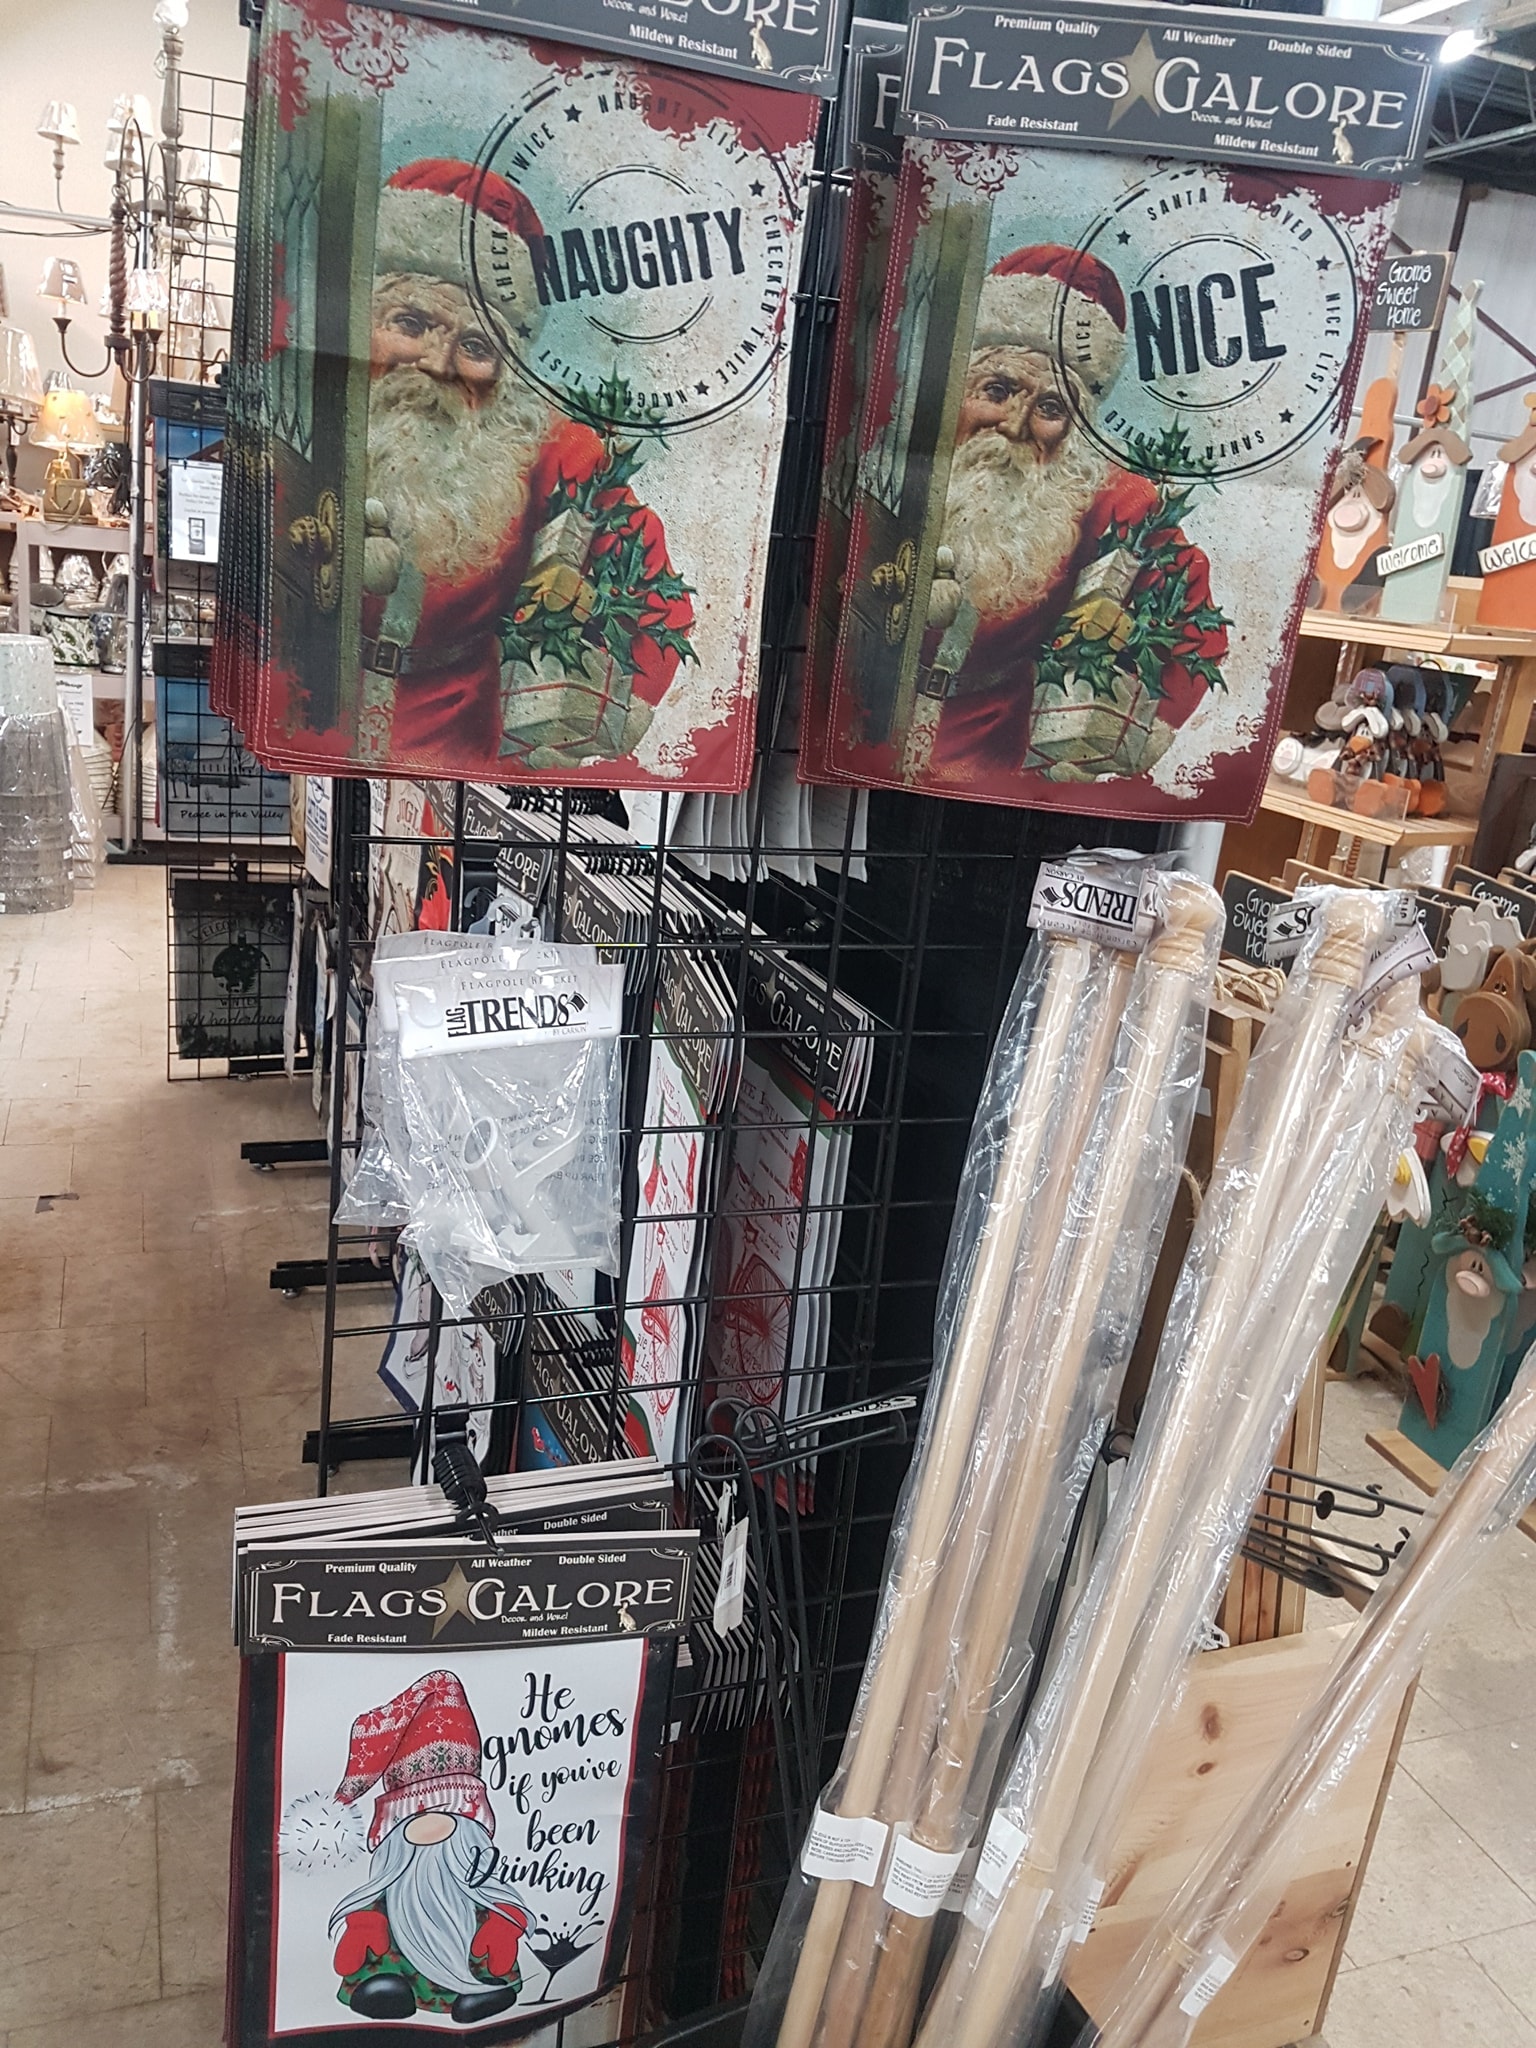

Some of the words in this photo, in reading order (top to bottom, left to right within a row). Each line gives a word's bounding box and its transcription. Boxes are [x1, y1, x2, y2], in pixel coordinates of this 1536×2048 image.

[629, 24, 674, 45] Mildew
[678, 35, 738, 60] Resistant
[994, 14, 1052, 31] Premium
[1055, 22, 1100, 38] Quality
[1162, 29, 1180, 43] All
[1184, 33, 1236, 47] Weather
[1268, 39, 1313, 55] Double
[1316, 44, 1352, 59] Sided
[927, 36, 1131, 99] FLAGS
[1154, 56, 1408, 129] GALORE
[987, 114, 1017, 128] Fade
[1020, 117, 1079, 132] Resistant
[505, 122, 556, 190] TWICE
[706, 122, 750, 166] LIST
[1213, 134, 1258, 150] Mildew
[1260, 139, 1319, 157] Resistant
[1146, 187, 1208, 221] SANTA
[1222, 184, 1314, 242] AOVED
[528, 207, 746, 306] NAUGHTY
[762, 214, 780, 318] CHECKED
[1389, 261, 1432, 283] Gnome
[1377, 281, 1420, 305] Sweet
[1130, 262, 1288, 382] NICE
[1325, 292, 1342, 338] NICE
[1387, 306, 1421, 328] Home
[719, 325, 766, 386] TWICE
[1076, 319, 1093, 363] NICE
[536, 348, 583, 389] LIST
[1304, 351, 1335, 395] LIST
[1103, 409, 1191, 460] AROVED
[1205, 429, 1265, 460] SANTA
[214, 809, 227, 818] in
[251, 809, 284, 821] Vlley
[1046, 866, 1075, 880] CARSON
[1060, 882, 1139, 925] TRENDS
[1233, 903, 1267, 938] Swe
[1246, 888, 1271, 918] Gno
[461, 977, 525, 991] FLAGPOLE
[531, 974, 578, 986] BCKET
[446, 1006, 468, 1037] FLAG
[461, 993, 569, 1034] TRENDS
[556, 1390, 601, 1464] GALOR
[543, 1517, 579, 1531] Double
[580, 1511, 608, 1525] Sided
[325, 1562, 376, 1574] Premium
[378, 1559, 418, 1574] Quality
[471, 1558, 486, 1569] All
[488, 1557, 532, 1568] Weather
[558, 1554, 595, 1565] Double
[597, 1553, 627, 1564] Sided
[272, 1583, 448, 1624] FLAGS
[467, 1578, 675, 1621] GALORE
[529, 1612, 544, 1622] and
[327, 1633, 353, 1643] Fade
[356, 1633, 408, 1644] Resistant
[522, 1625, 558, 1638] Mildew
[560, 1624, 609, 1636] Resistant
[520, 1672, 576, 1723] He
[484, 1708, 627, 1791] gnomes
[508, 1773, 534, 1815] if
[541, 1757, 623, 1803] you've
[527, 1809, 601, 1852] been
[464, 1845, 611, 1917] Drinking
